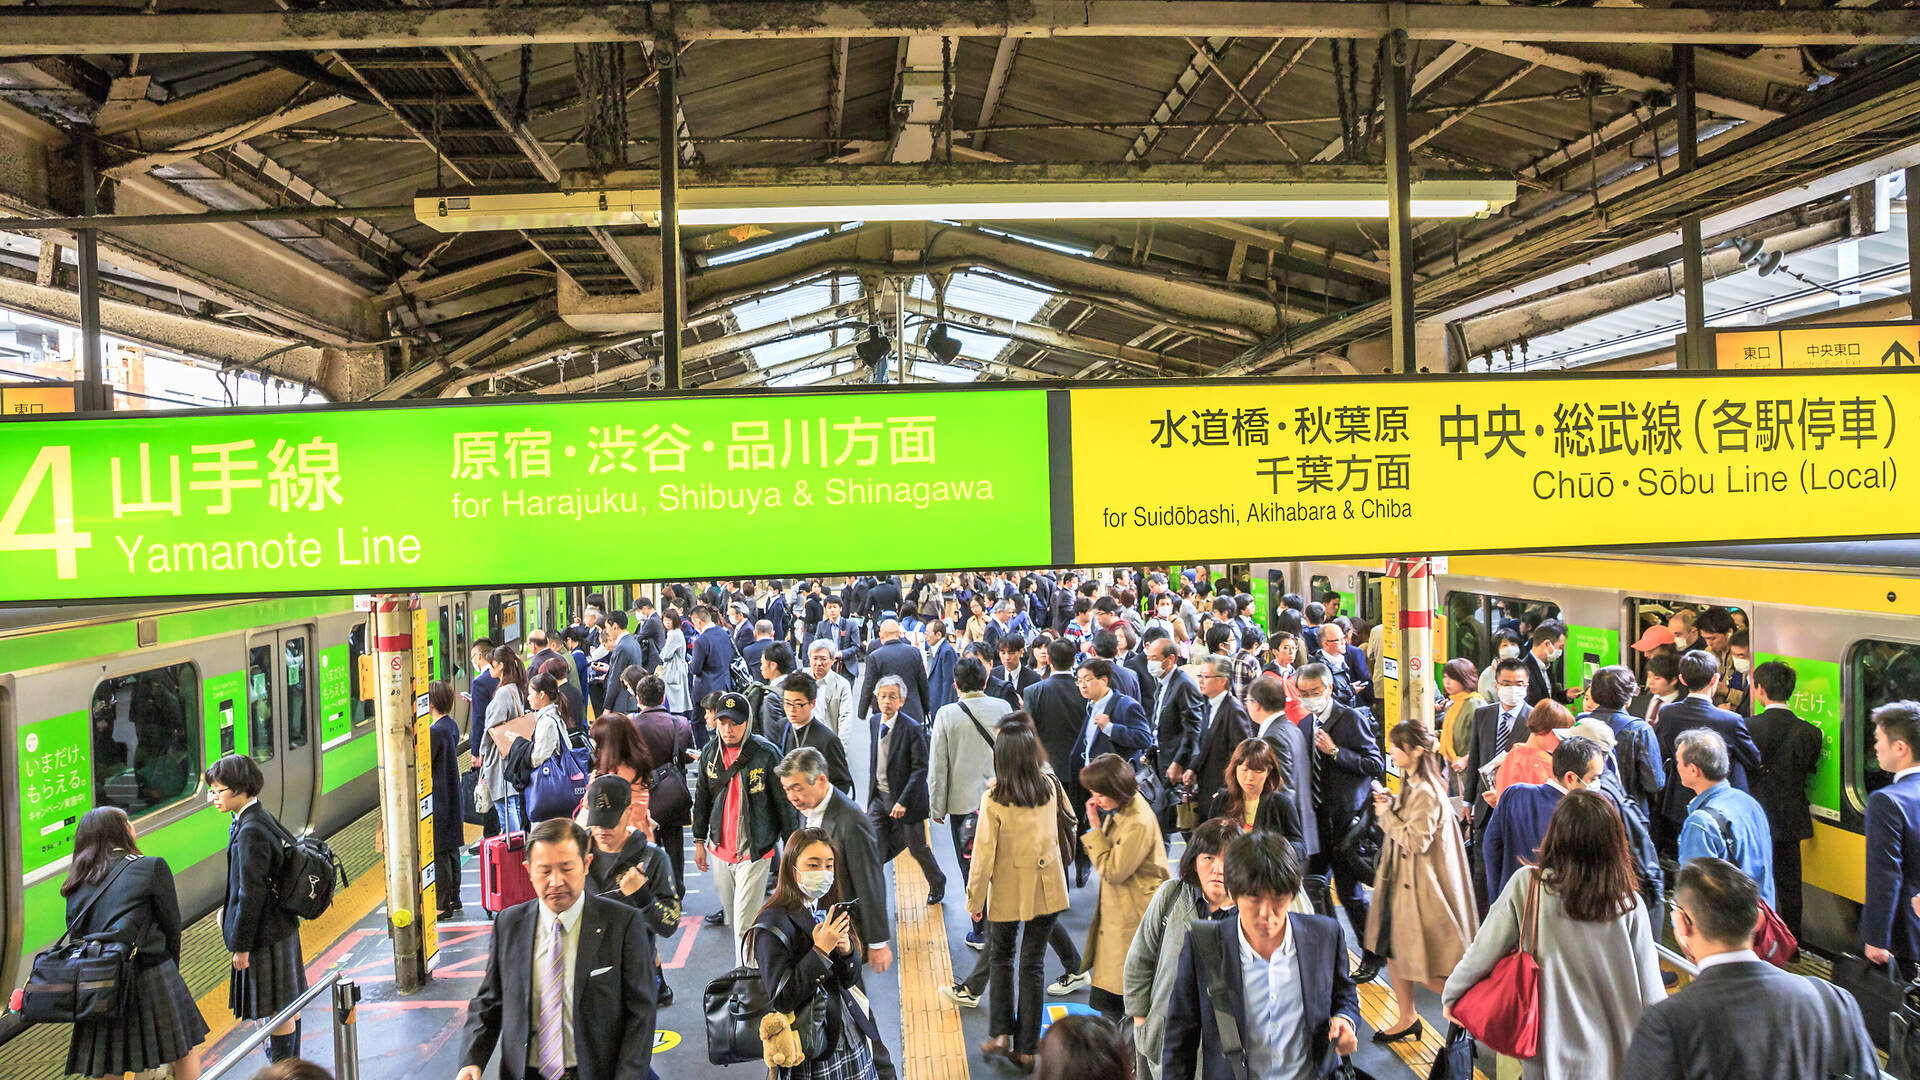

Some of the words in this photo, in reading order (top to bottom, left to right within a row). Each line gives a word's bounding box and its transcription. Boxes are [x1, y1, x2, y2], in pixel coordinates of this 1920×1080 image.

[1743, 346, 1770, 360] 東口
[1807, 343, 1860, 359] 中央東口
[1150, 405, 1410, 449] 水道橋・秋葉原
[450, 415, 937, 481] 原宿・渋谷・品川方面
[111, 436, 344, 518] 山手線
[1256, 453, 1411, 495] 千葉方面
[1727, 465, 1788, 493] Line
[1799, 456, 1897, 495] (Local)
[0, 445, 92, 579] 4
[452, 492, 491, 519] for
[502, 487, 647, 521] Harajuku,
[659, 482, 783, 515] Shibuya
[793, 480, 814, 507] &
[826, 477, 994, 509] Shinagawa
[1103, 507, 1127, 528] for
[1133, 503, 1240, 527] Suidōbashi,
[1247, 501, 1337, 523] Akihabara
[1343, 499, 1355, 520] &
[1361, 498, 1412, 519] Chiba
[115, 531, 322, 573] Yamanote
[337, 526, 421, 566] Line
[1787, 690, 1833, 717] だけ、
[26, 744, 86, 777] いまだけ、
[27, 769, 86, 804] もらえる。
